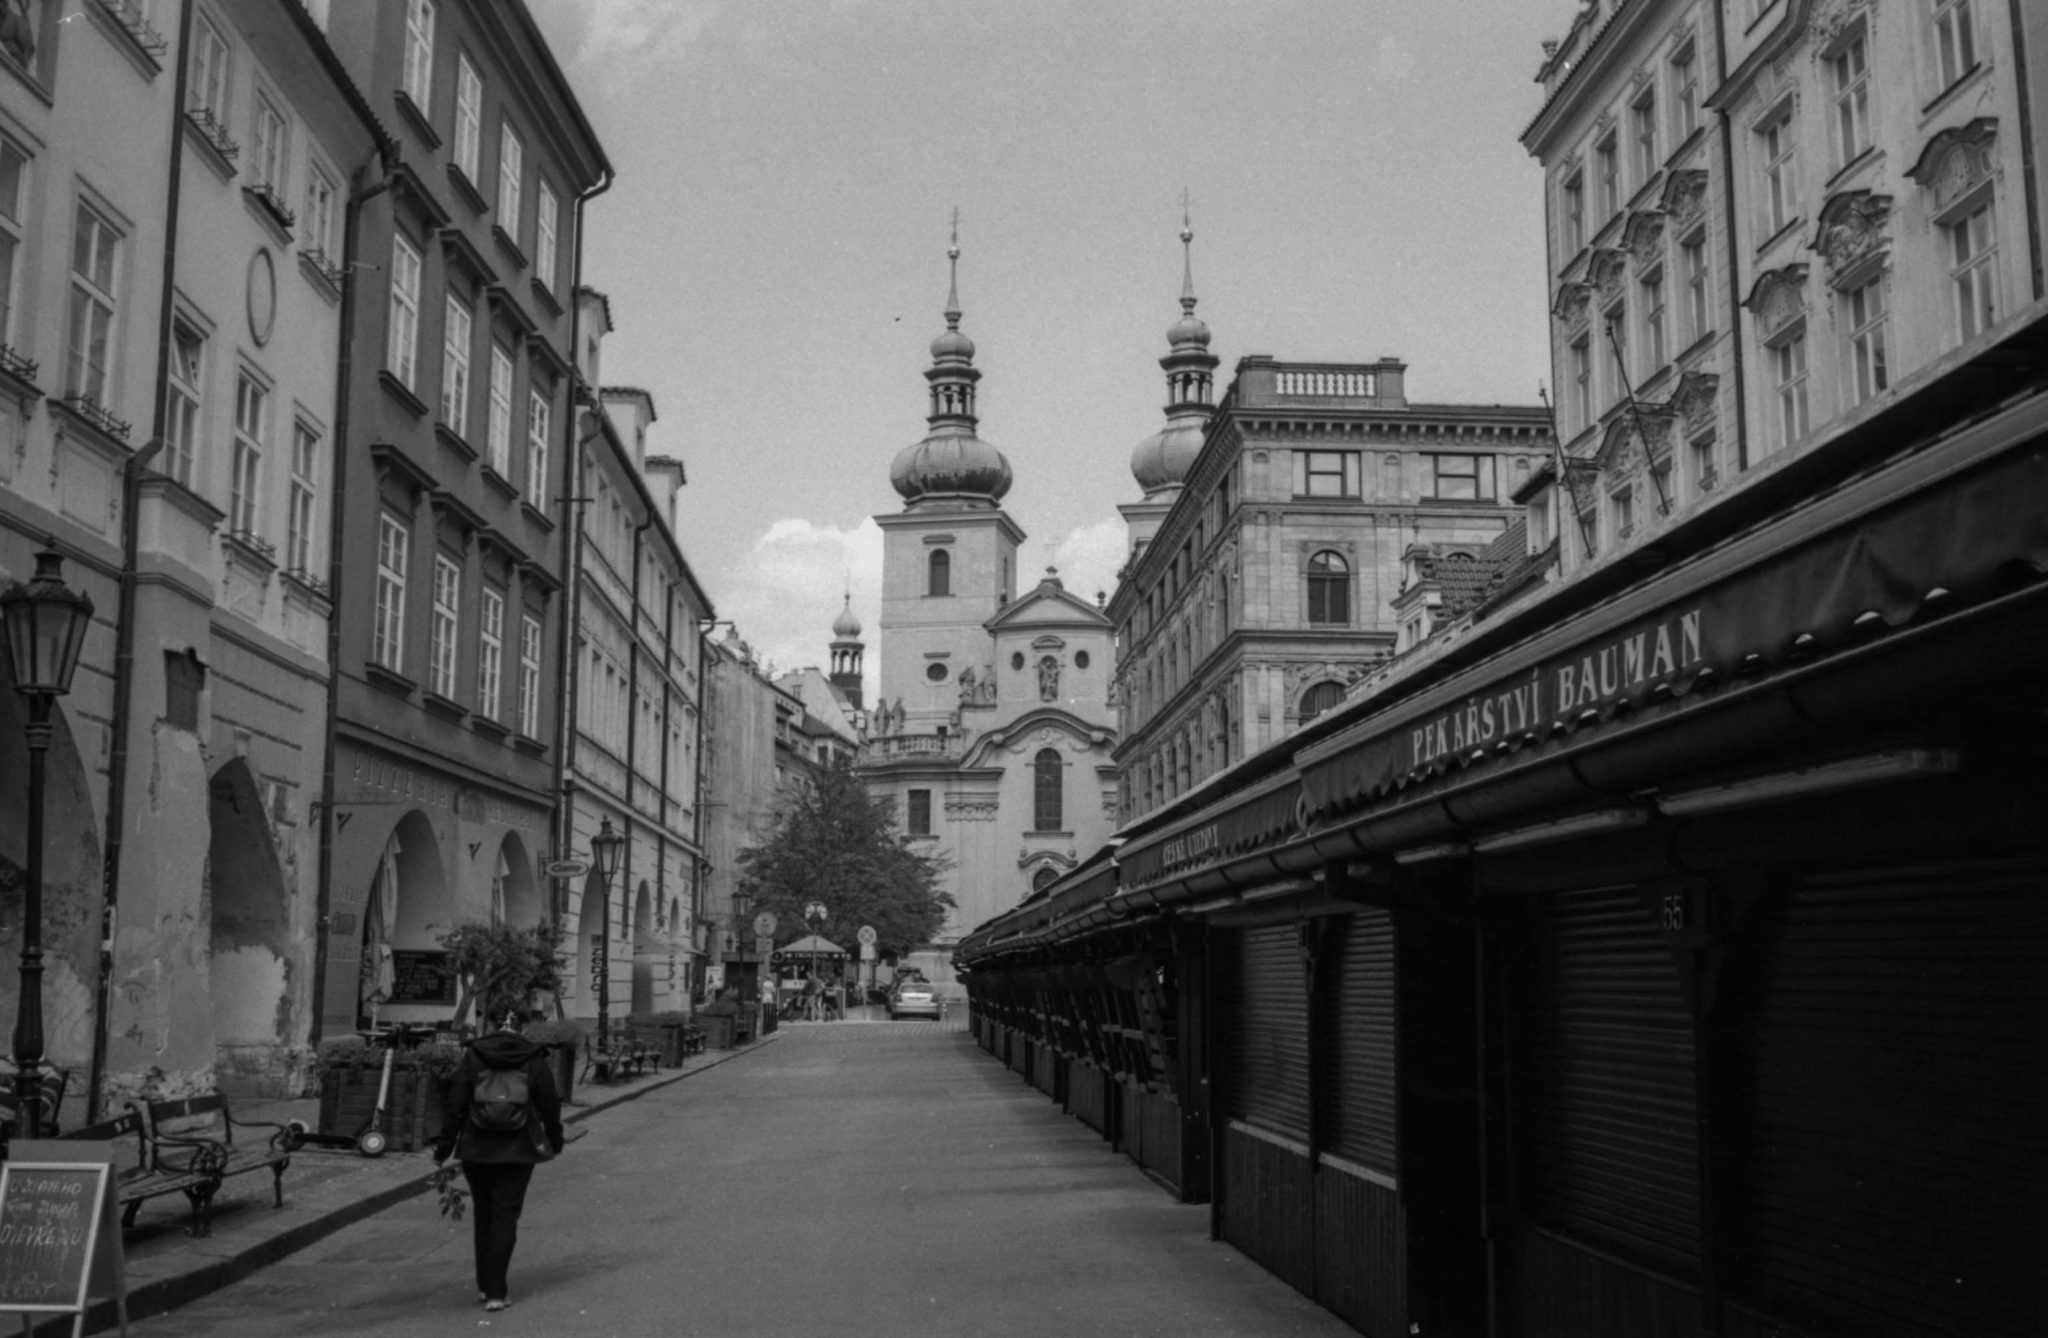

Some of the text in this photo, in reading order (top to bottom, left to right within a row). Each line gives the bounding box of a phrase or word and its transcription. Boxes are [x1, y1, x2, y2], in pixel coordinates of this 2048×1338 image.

[1412, 610, 1702, 767] PEKAŘSTVÍ BAUMAN
[1663, 895, 1683, 931] 55
